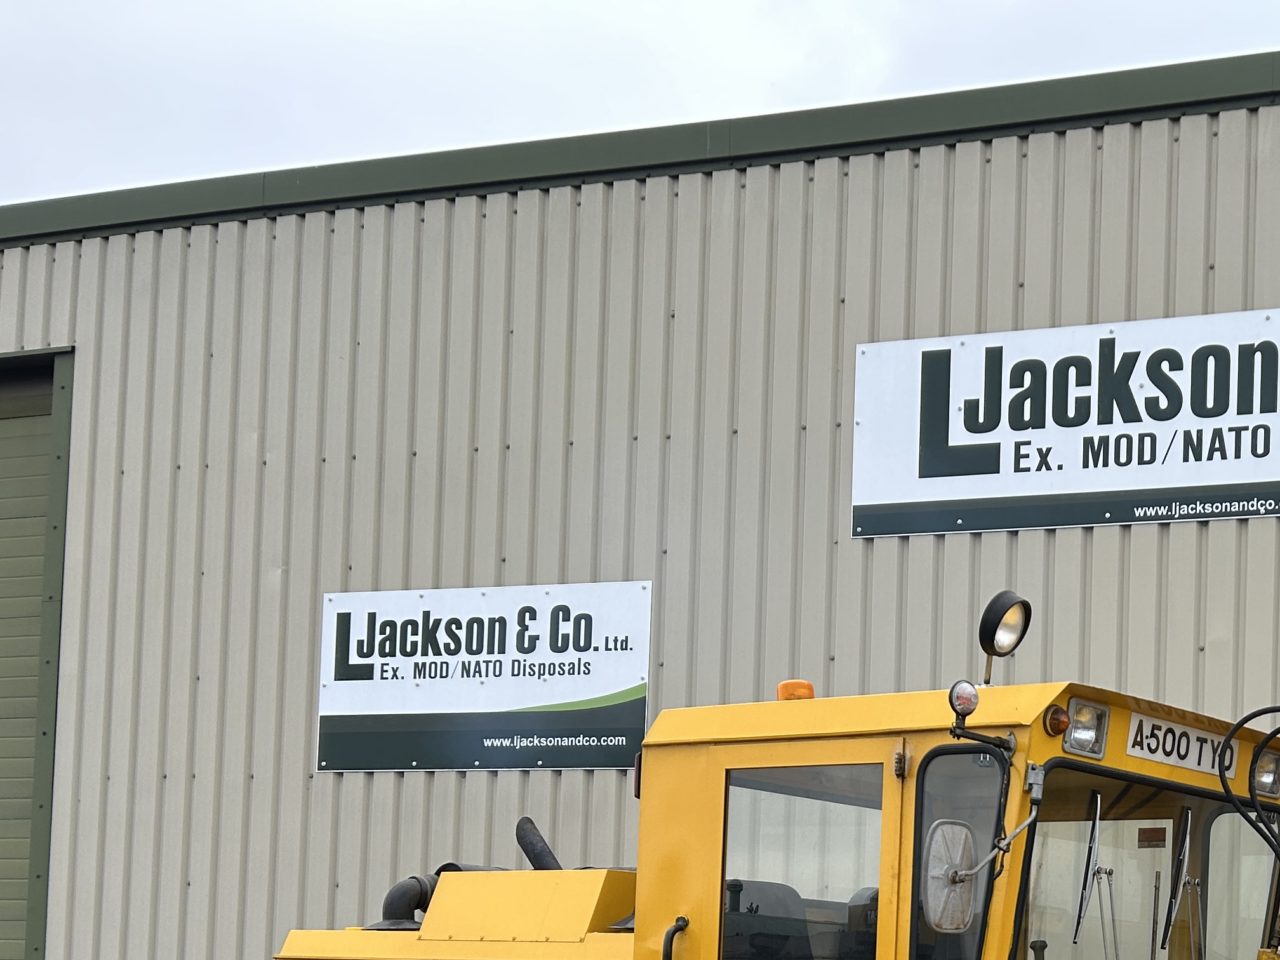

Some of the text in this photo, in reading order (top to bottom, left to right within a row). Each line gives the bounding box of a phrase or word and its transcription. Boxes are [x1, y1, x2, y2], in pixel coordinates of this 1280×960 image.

[1013, 440, 1064, 474] Ex.
[1082, 424, 1271, 469] MOD/NATO
[515, 605, 541, 655] &
[549, 604, 600, 654] Co.
[604, 635, 634, 652] Ltd.
[379, 657, 591, 681] Ex. MOD/NATO Disposals
[483, 734, 627, 750] www.ljacksonandco.com
